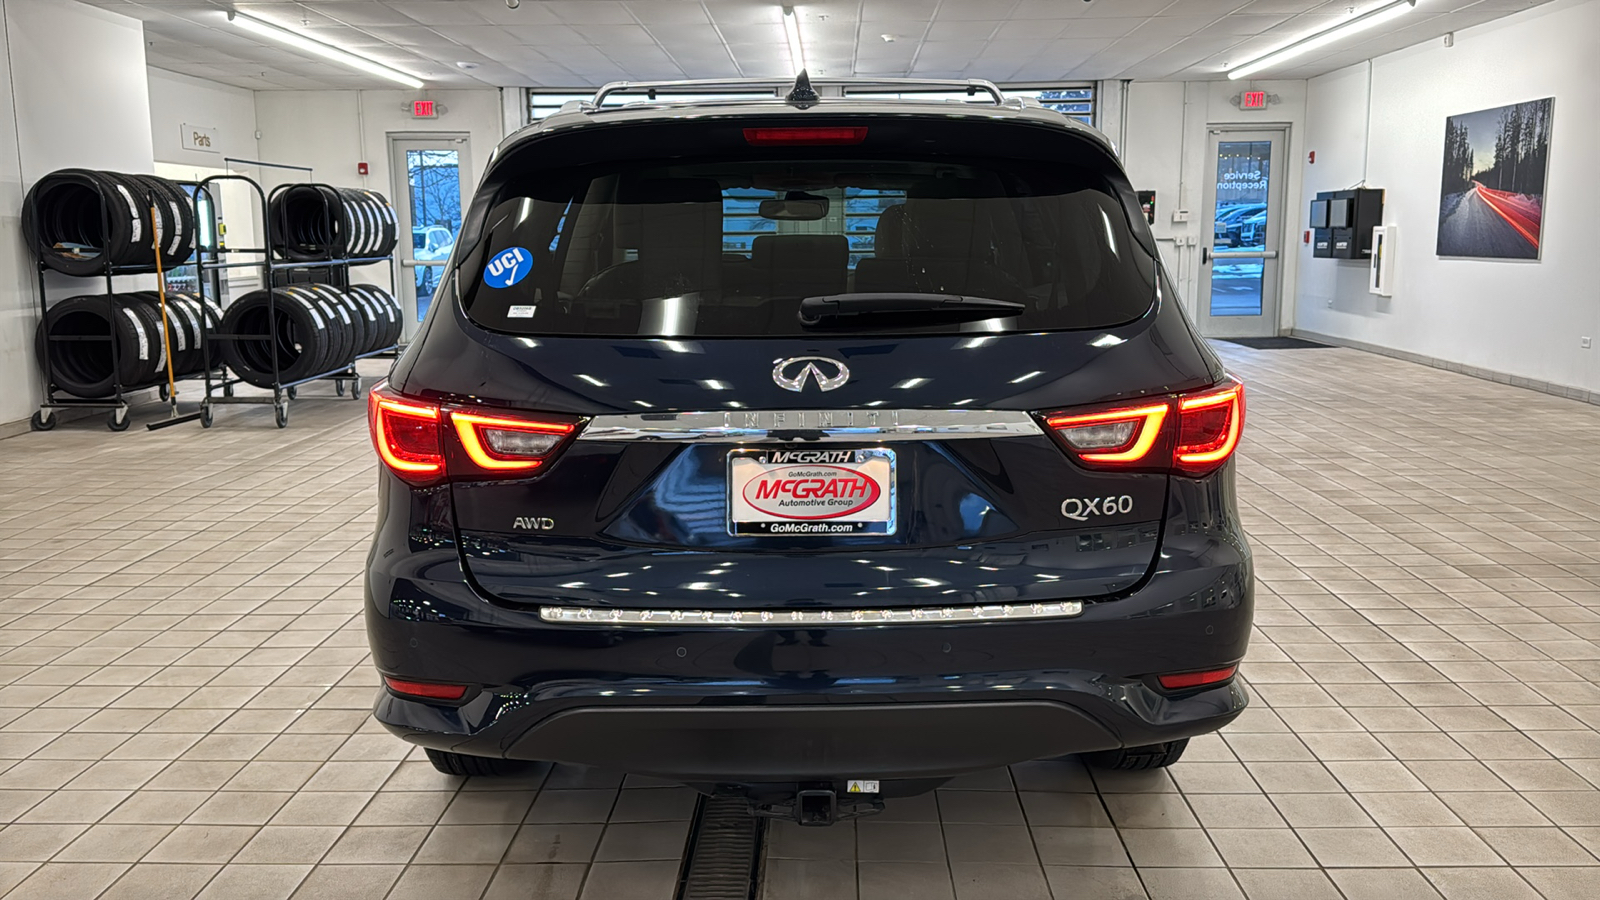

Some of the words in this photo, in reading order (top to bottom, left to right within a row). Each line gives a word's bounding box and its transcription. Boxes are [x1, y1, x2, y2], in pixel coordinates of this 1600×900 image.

[1244, 91, 1265, 107] EXIT
[414, 100, 434, 116] EXIT
[193, 131, 211, 147] Parts
[487, 247, 524, 277] UCI
[724, 411, 900, 428] INFINITI
[778, 499, 826, 507] Automotive
[827, 499, 853, 508] Group
[1061, 494, 1133, 521] QX60
[512, 516, 555, 530] AWD
[770, 523, 853, 533] GoMcGrath.com
